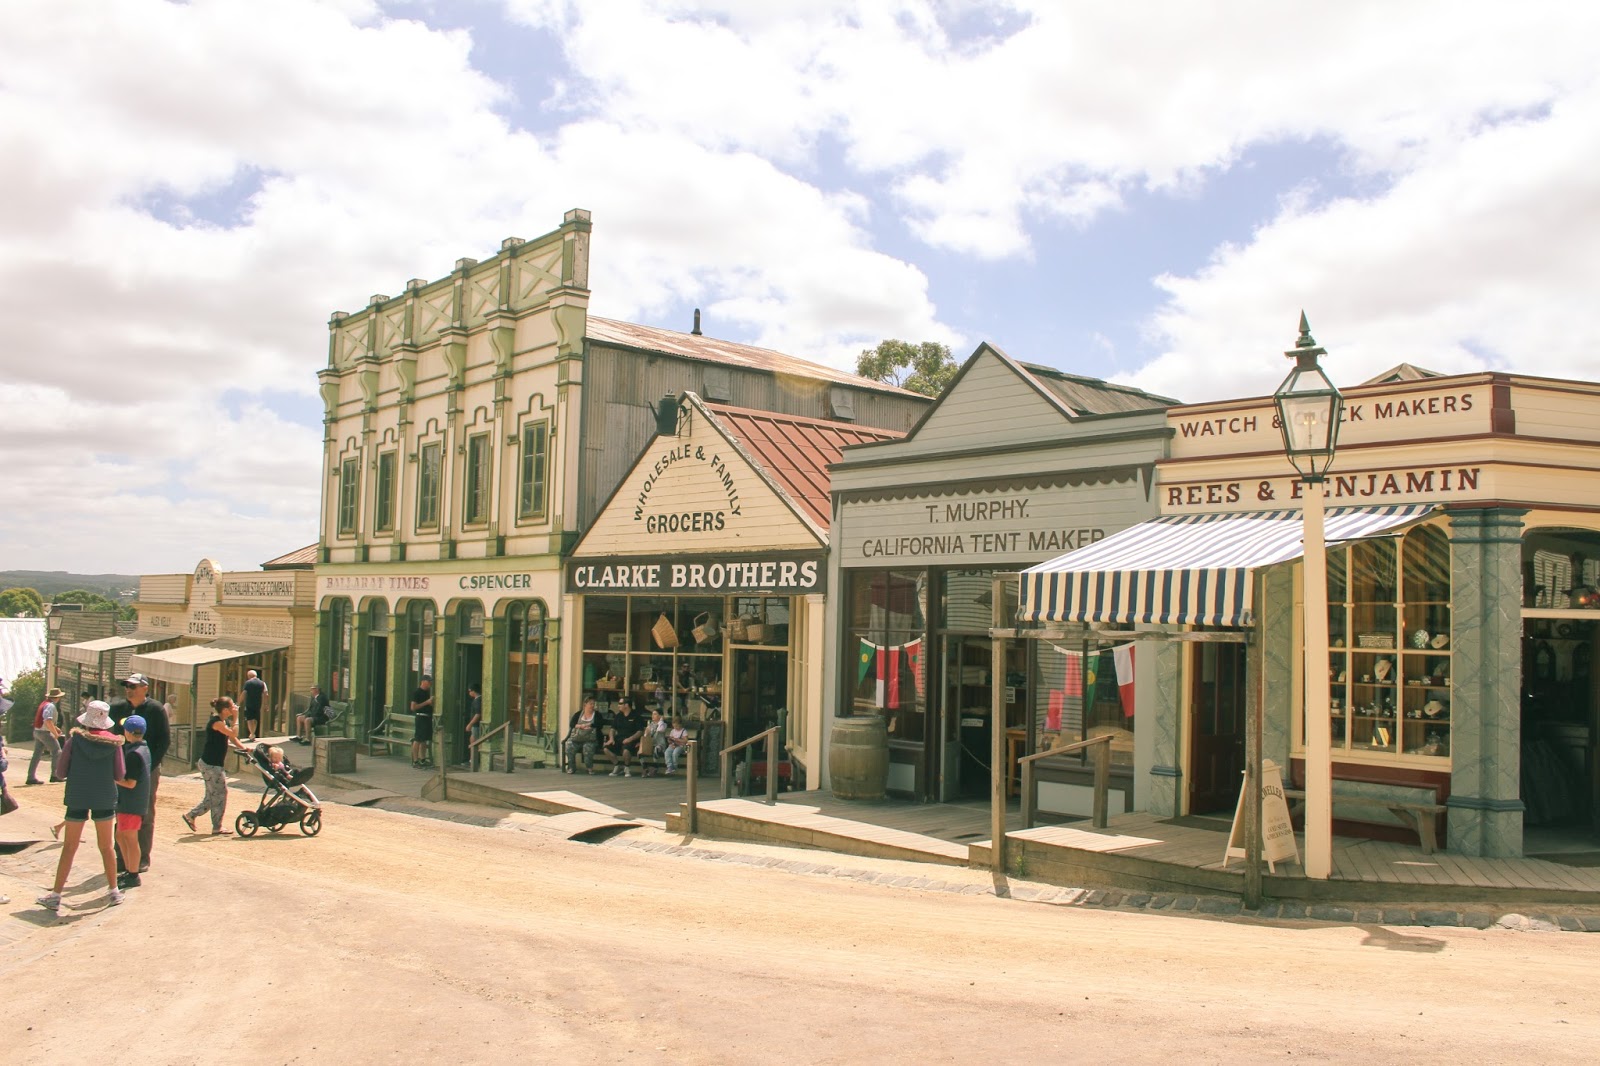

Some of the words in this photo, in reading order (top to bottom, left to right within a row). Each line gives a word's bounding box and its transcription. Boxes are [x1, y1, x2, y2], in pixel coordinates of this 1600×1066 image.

[1181, 415, 1256, 438] WATCH
[1375, 393, 1473, 420] MAKERS
[633, 443, 691, 521] WHOLESALE
[695, 445, 706, 461] &
[710, 454, 741, 517] FAMILY
[1167, 483, 1240, 506] REES
[1257, 480, 1276, 501] &
[646, 511, 725, 535] GROCERS
[926, 504, 939, 524] T.
[945, 498, 1029, 522] MURPHY.
[862, 534, 964, 558] CALIFORNIA
[970, 532, 1021, 554] TENT
[389, 577, 430, 589] TIMES
[574, 564, 661, 588] CLARKE
[670, 560, 818, 588] BROTHERS
[224, 581, 250, 596] AUSTRALIAN
[267, 581, 293, 596] COMPANY
[189, 622, 216, 635] STABLES
[193, 611, 210, 621] HOTEL
[1262, 785, 1283, 800] WELLER
